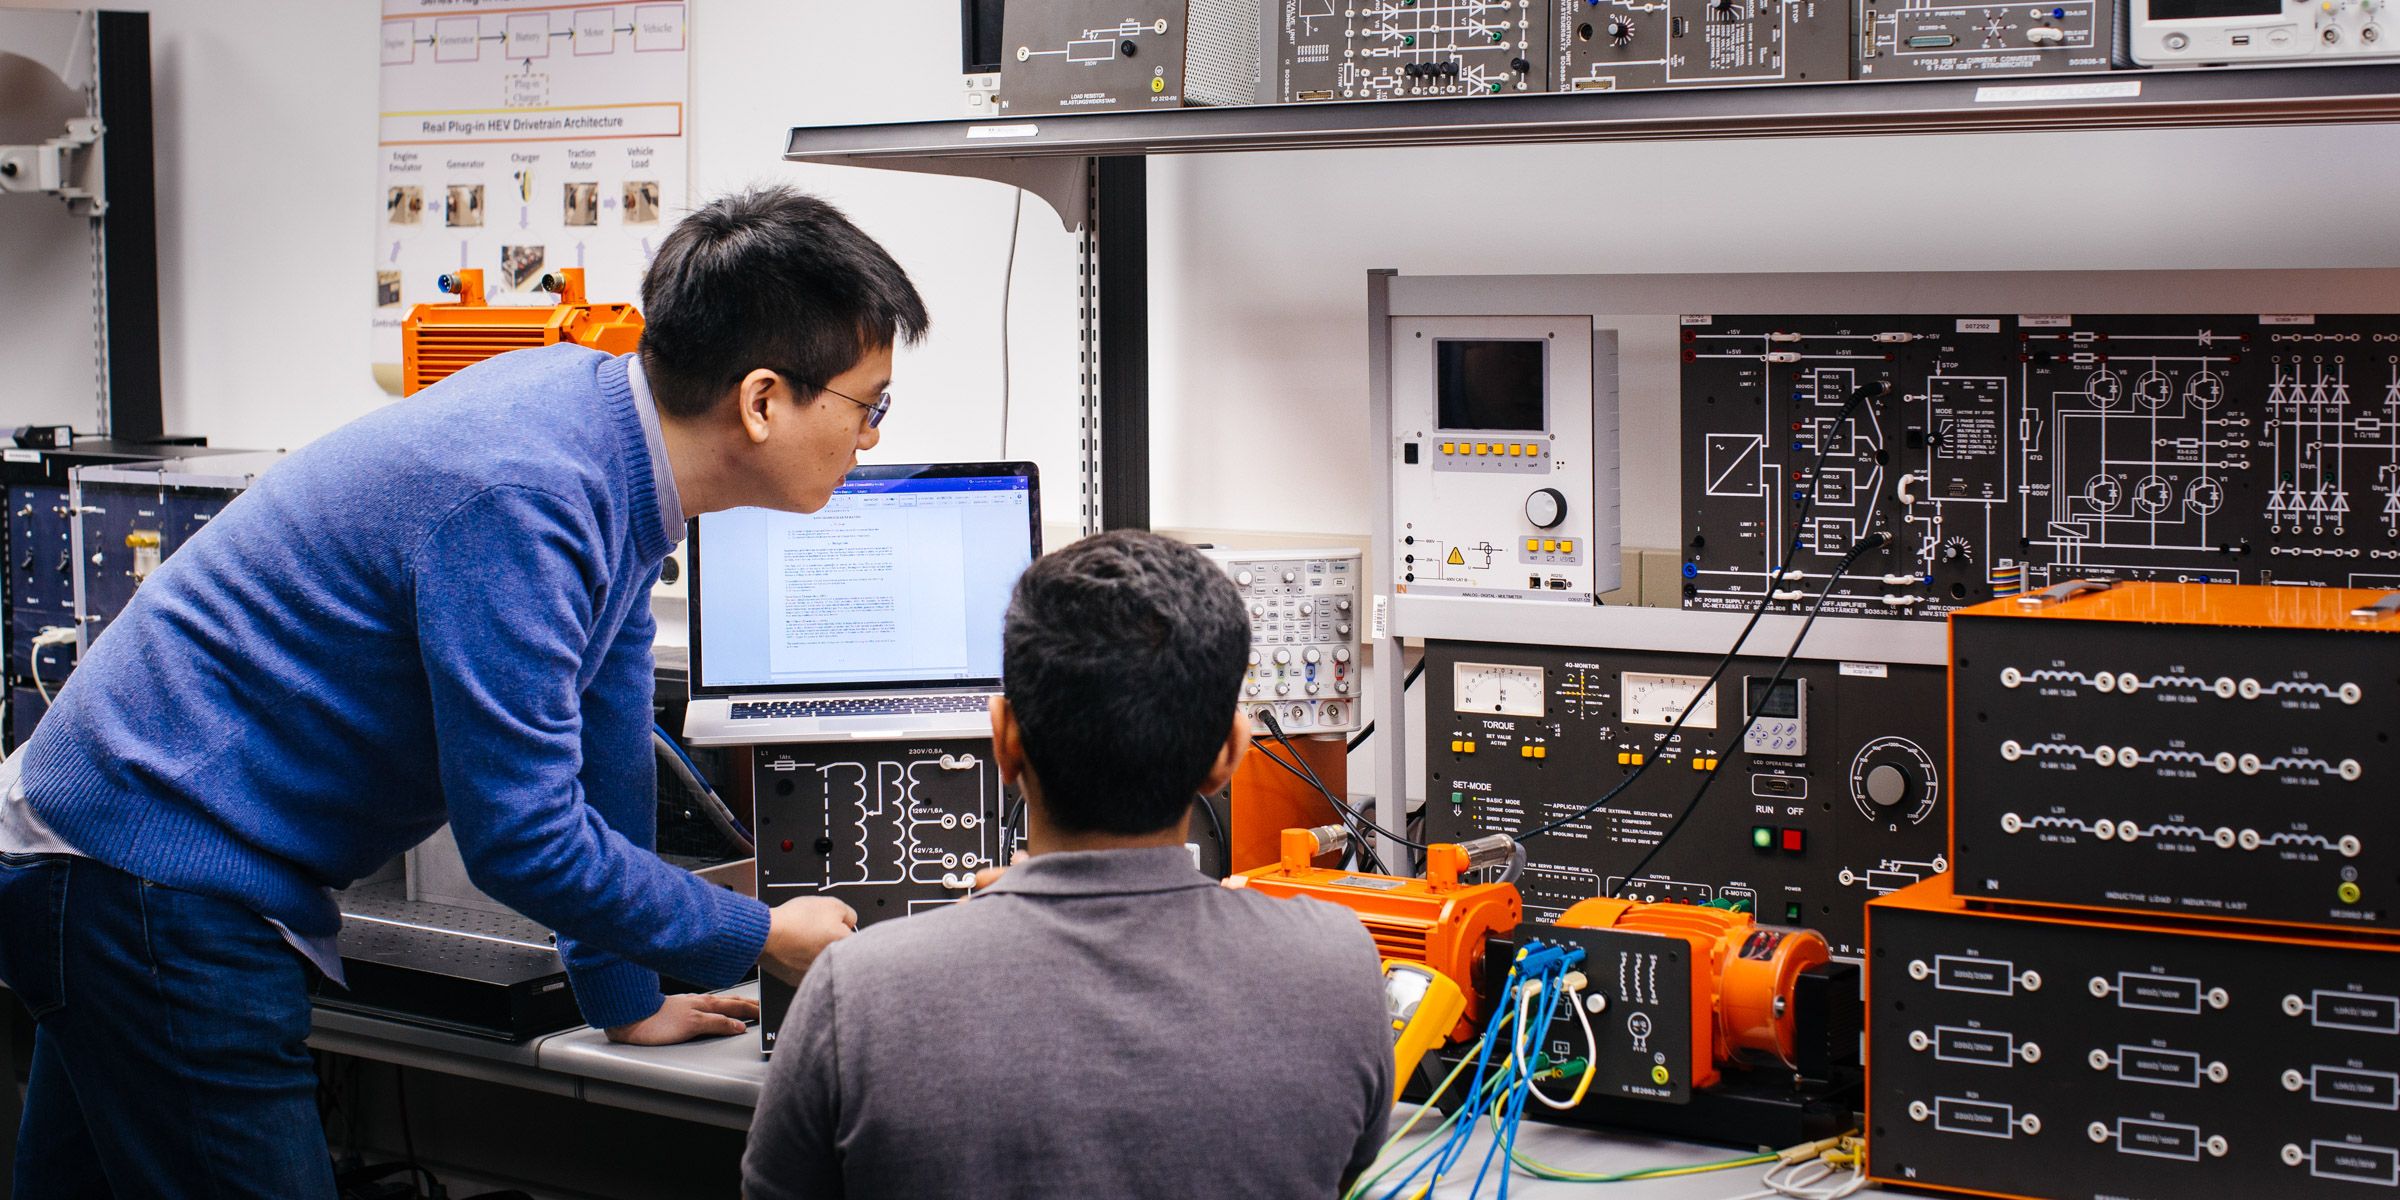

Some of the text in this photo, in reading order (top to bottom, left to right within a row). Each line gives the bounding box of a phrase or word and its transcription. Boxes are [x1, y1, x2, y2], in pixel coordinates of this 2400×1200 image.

[422, 115, 624, 135] Real Plug-in HEV Drivetrain Architecture
[393, 151, 419, 162] Engine
[568, 149, 597, 158] Traction
[627, 147, 654, 156] Vehicle
[511, 153, 541, 163] Charger
[631, 158, 650, 168] Load
[389, 162, 423, 172] Emulator
[446, 159, 485, 169] Generator
[570, 160, 593, 170] Motor
[1396, 584, 1407, 594] IN
[1684, 599, 1692, 607] IN
[1792, 603, 1801, 611] IN
[1904, 608, 1913, 616] IN
[1482, 720, 1515, 731] TORQUE
[1654, 733, 1682, 743] SPED
[1765, 760, 1793, 768] OPERATING
[1453, 780, 1492, 791] SET-MODE
[1505, 798, 1520, 806] MODE
[1755, 804, 1774, 815] RUN
[1787, 806, 1804, 816] OFF
[1634, 881, 1647, 889] LIFT
